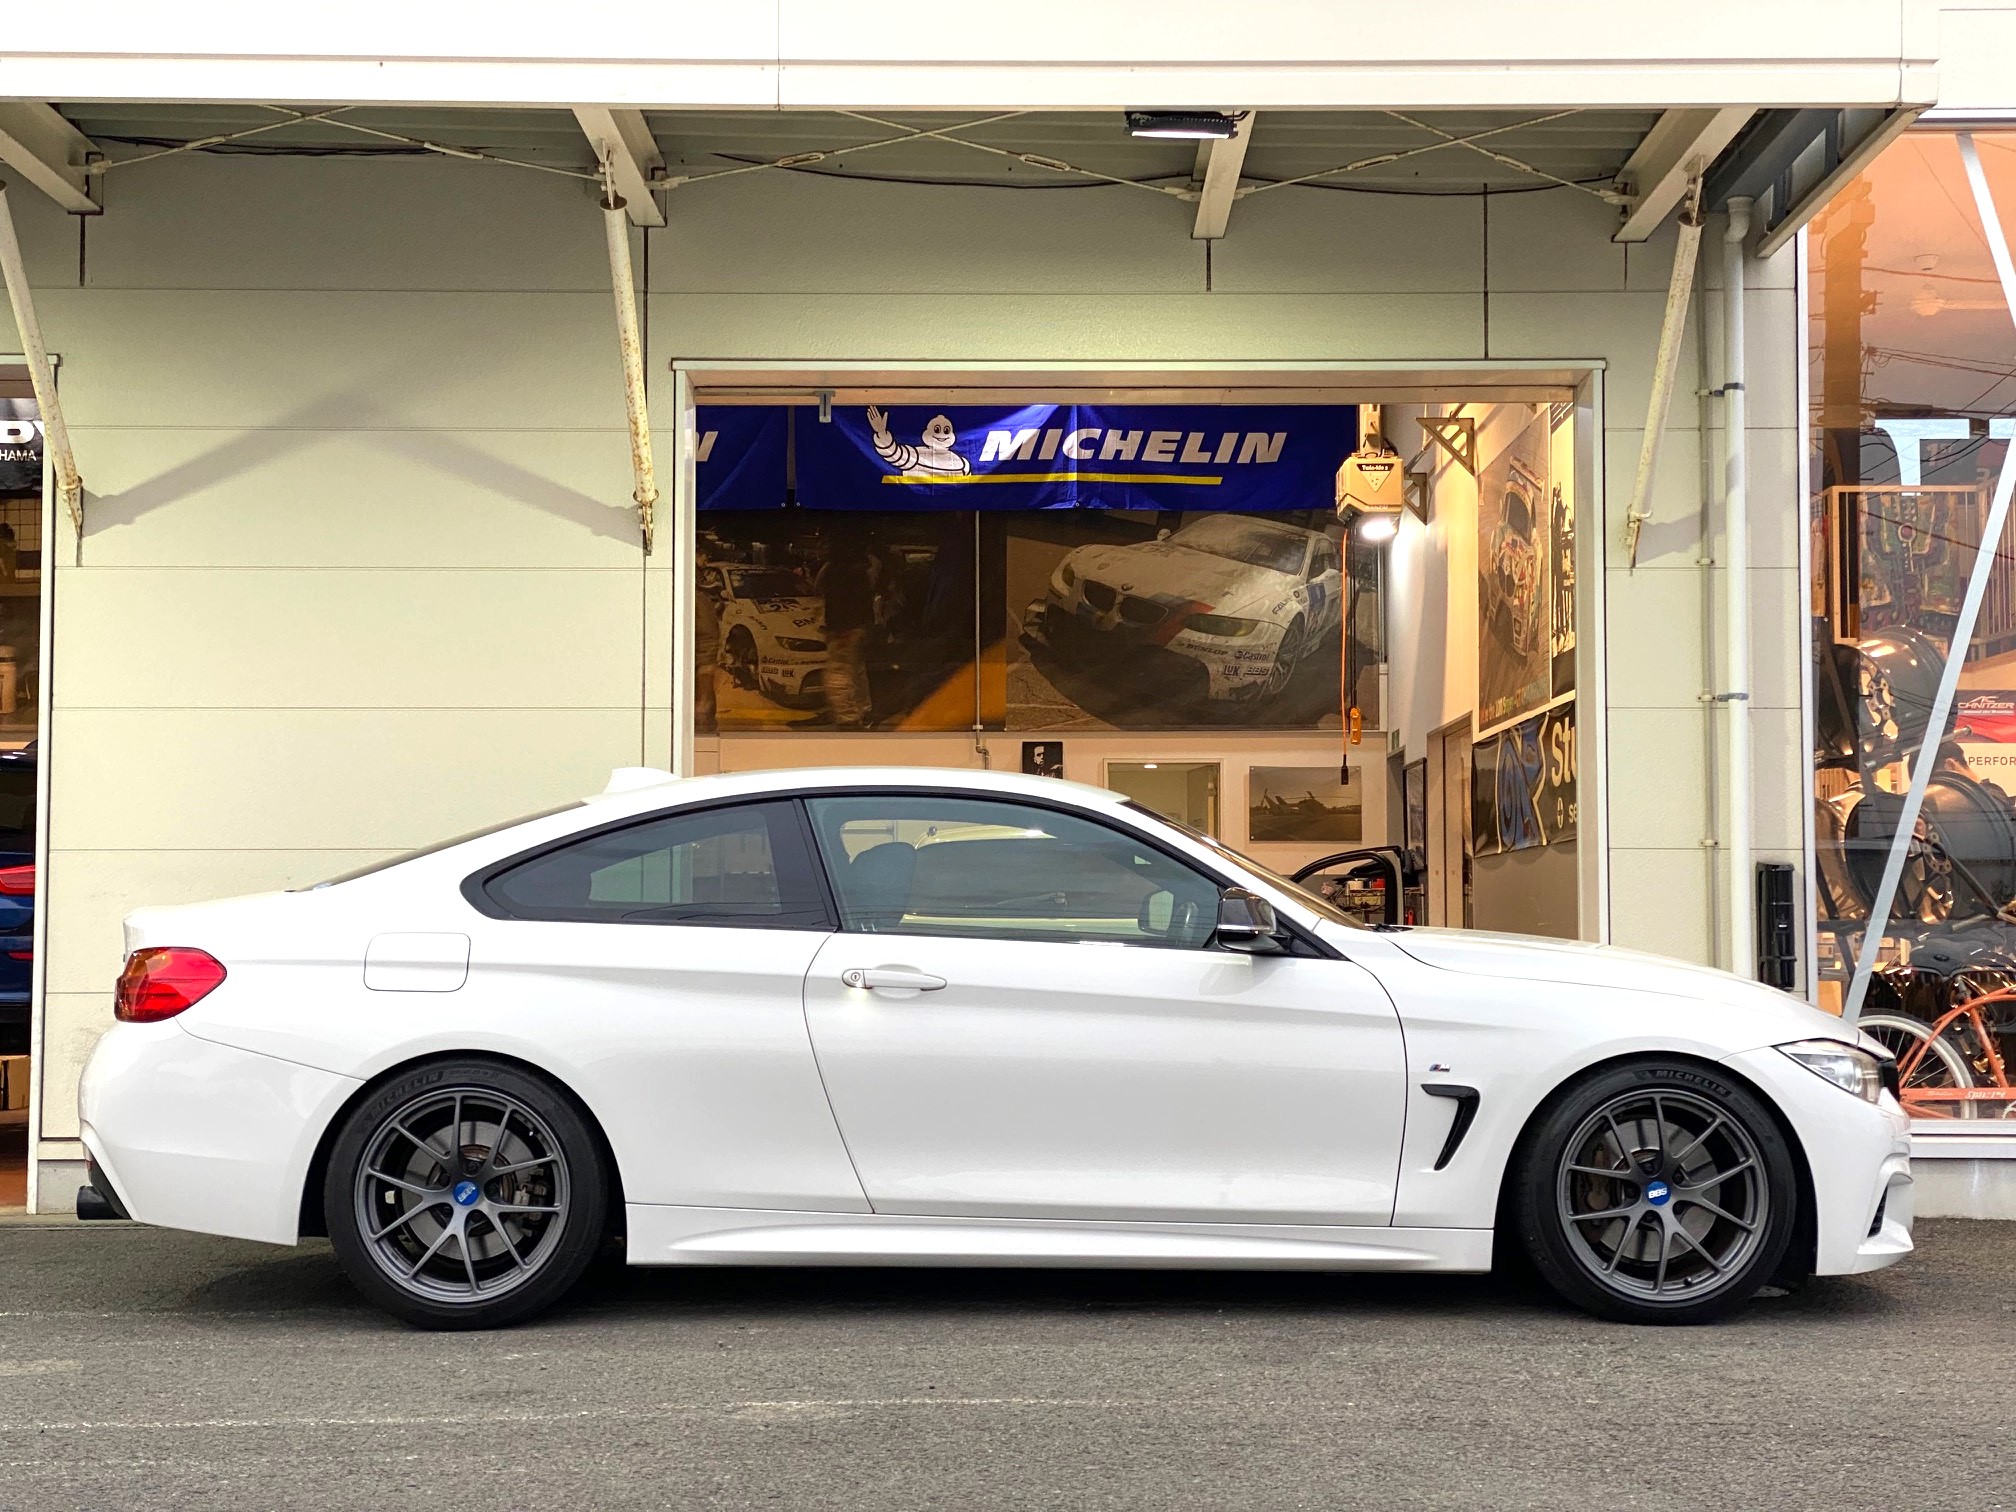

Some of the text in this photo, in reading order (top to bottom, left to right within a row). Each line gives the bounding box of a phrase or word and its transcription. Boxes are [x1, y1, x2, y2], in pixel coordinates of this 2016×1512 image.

[979, 428, 1287, 464] MICHELIN
[0, 449, 37, 461] HAMA
[1242, 651, 1270, 661] Castrol
[1968, 695, 1999, 704] AC
[1968, 756, 2016, 766] PERFOR
[1656, 1070, 1728, 1096] MICHELIN
[1648, 1187, 1668, 1199] BBS
